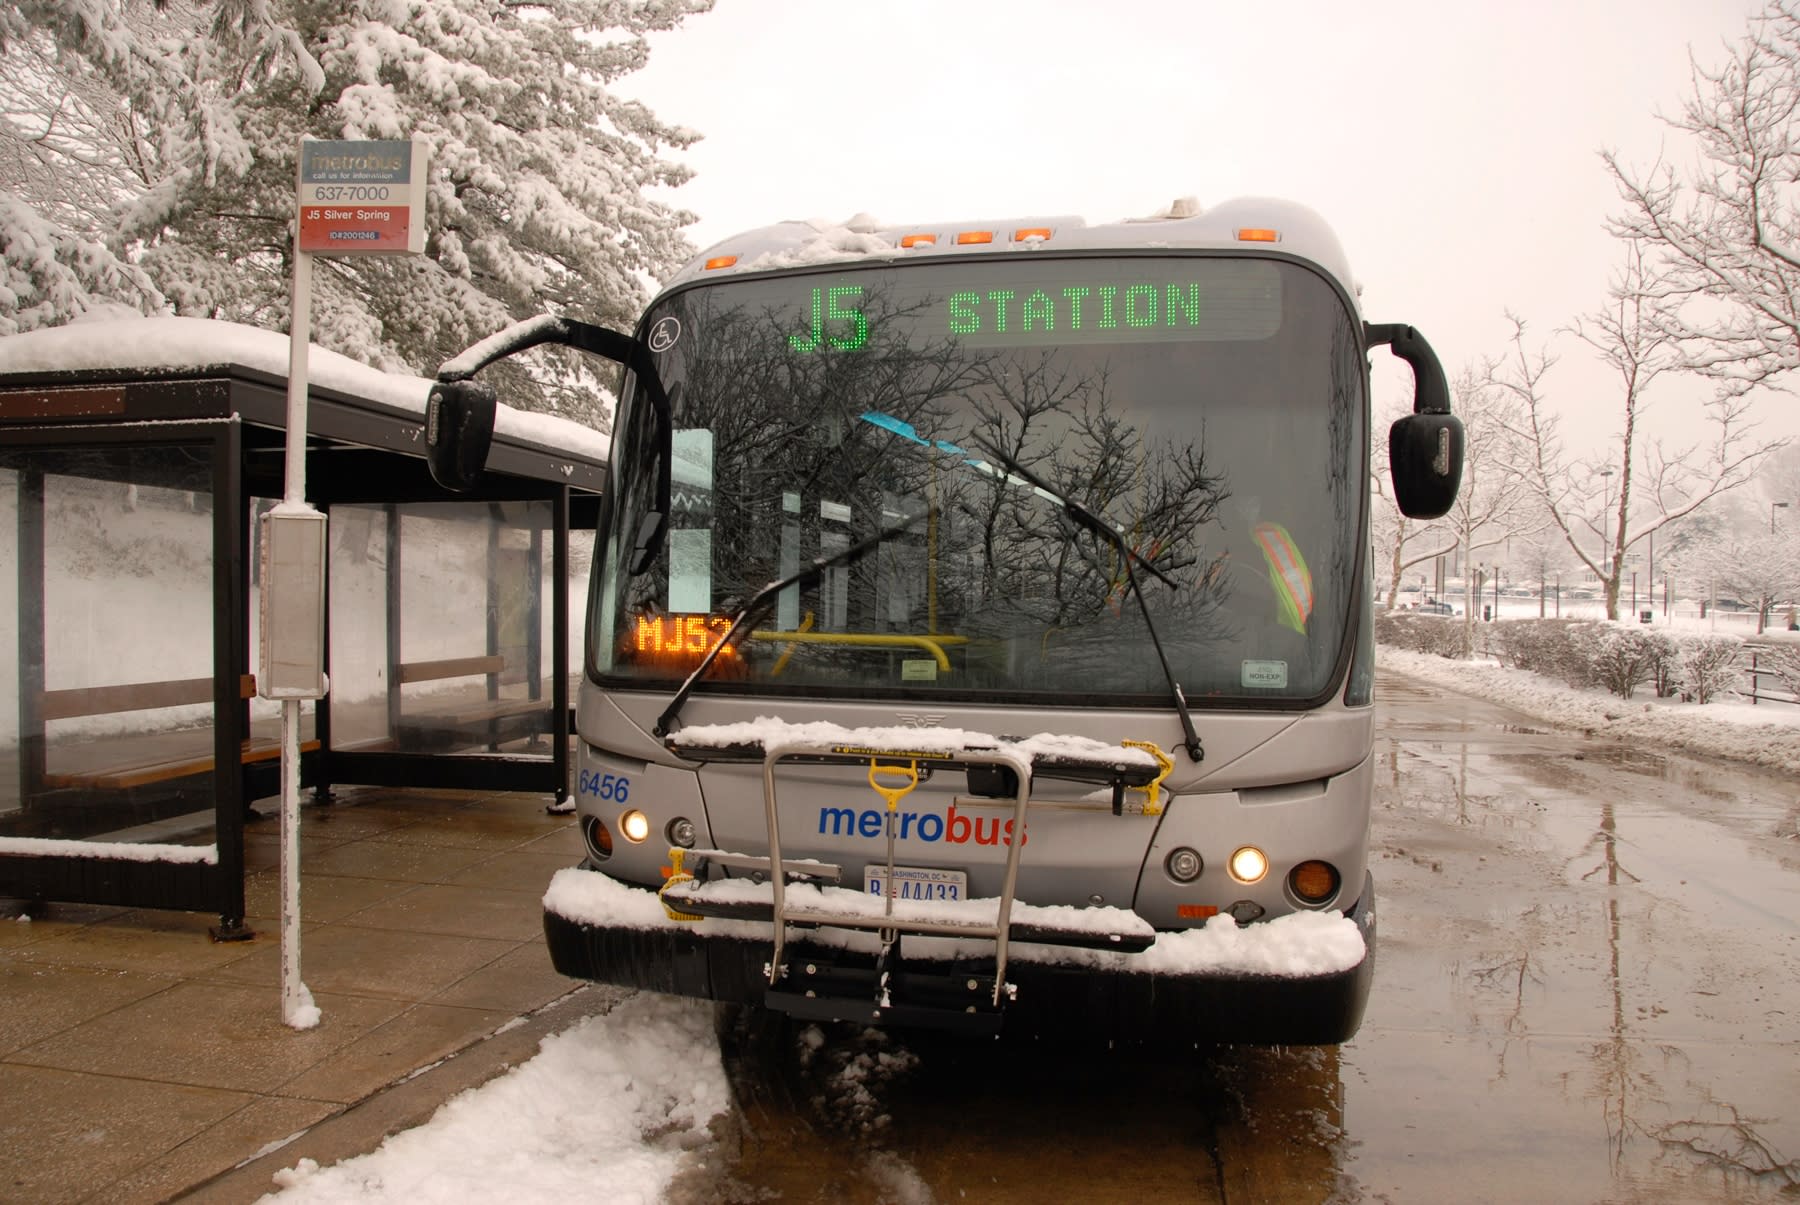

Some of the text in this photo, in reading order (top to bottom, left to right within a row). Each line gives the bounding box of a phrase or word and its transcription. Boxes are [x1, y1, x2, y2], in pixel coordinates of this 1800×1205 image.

[311, 152, 402, 171] metrobus
[312, 172, 326, 180] call
[340, 172, 350, 180] for
[315, 186, 389, 200] 637-7000
[307, 210, 390, 221] J5 Silver Spring
[789, 283, 1199, 352] J5 STATION
[580, 769, 630, 804] 6456
[818, 807, 1028, 847] metrobus
